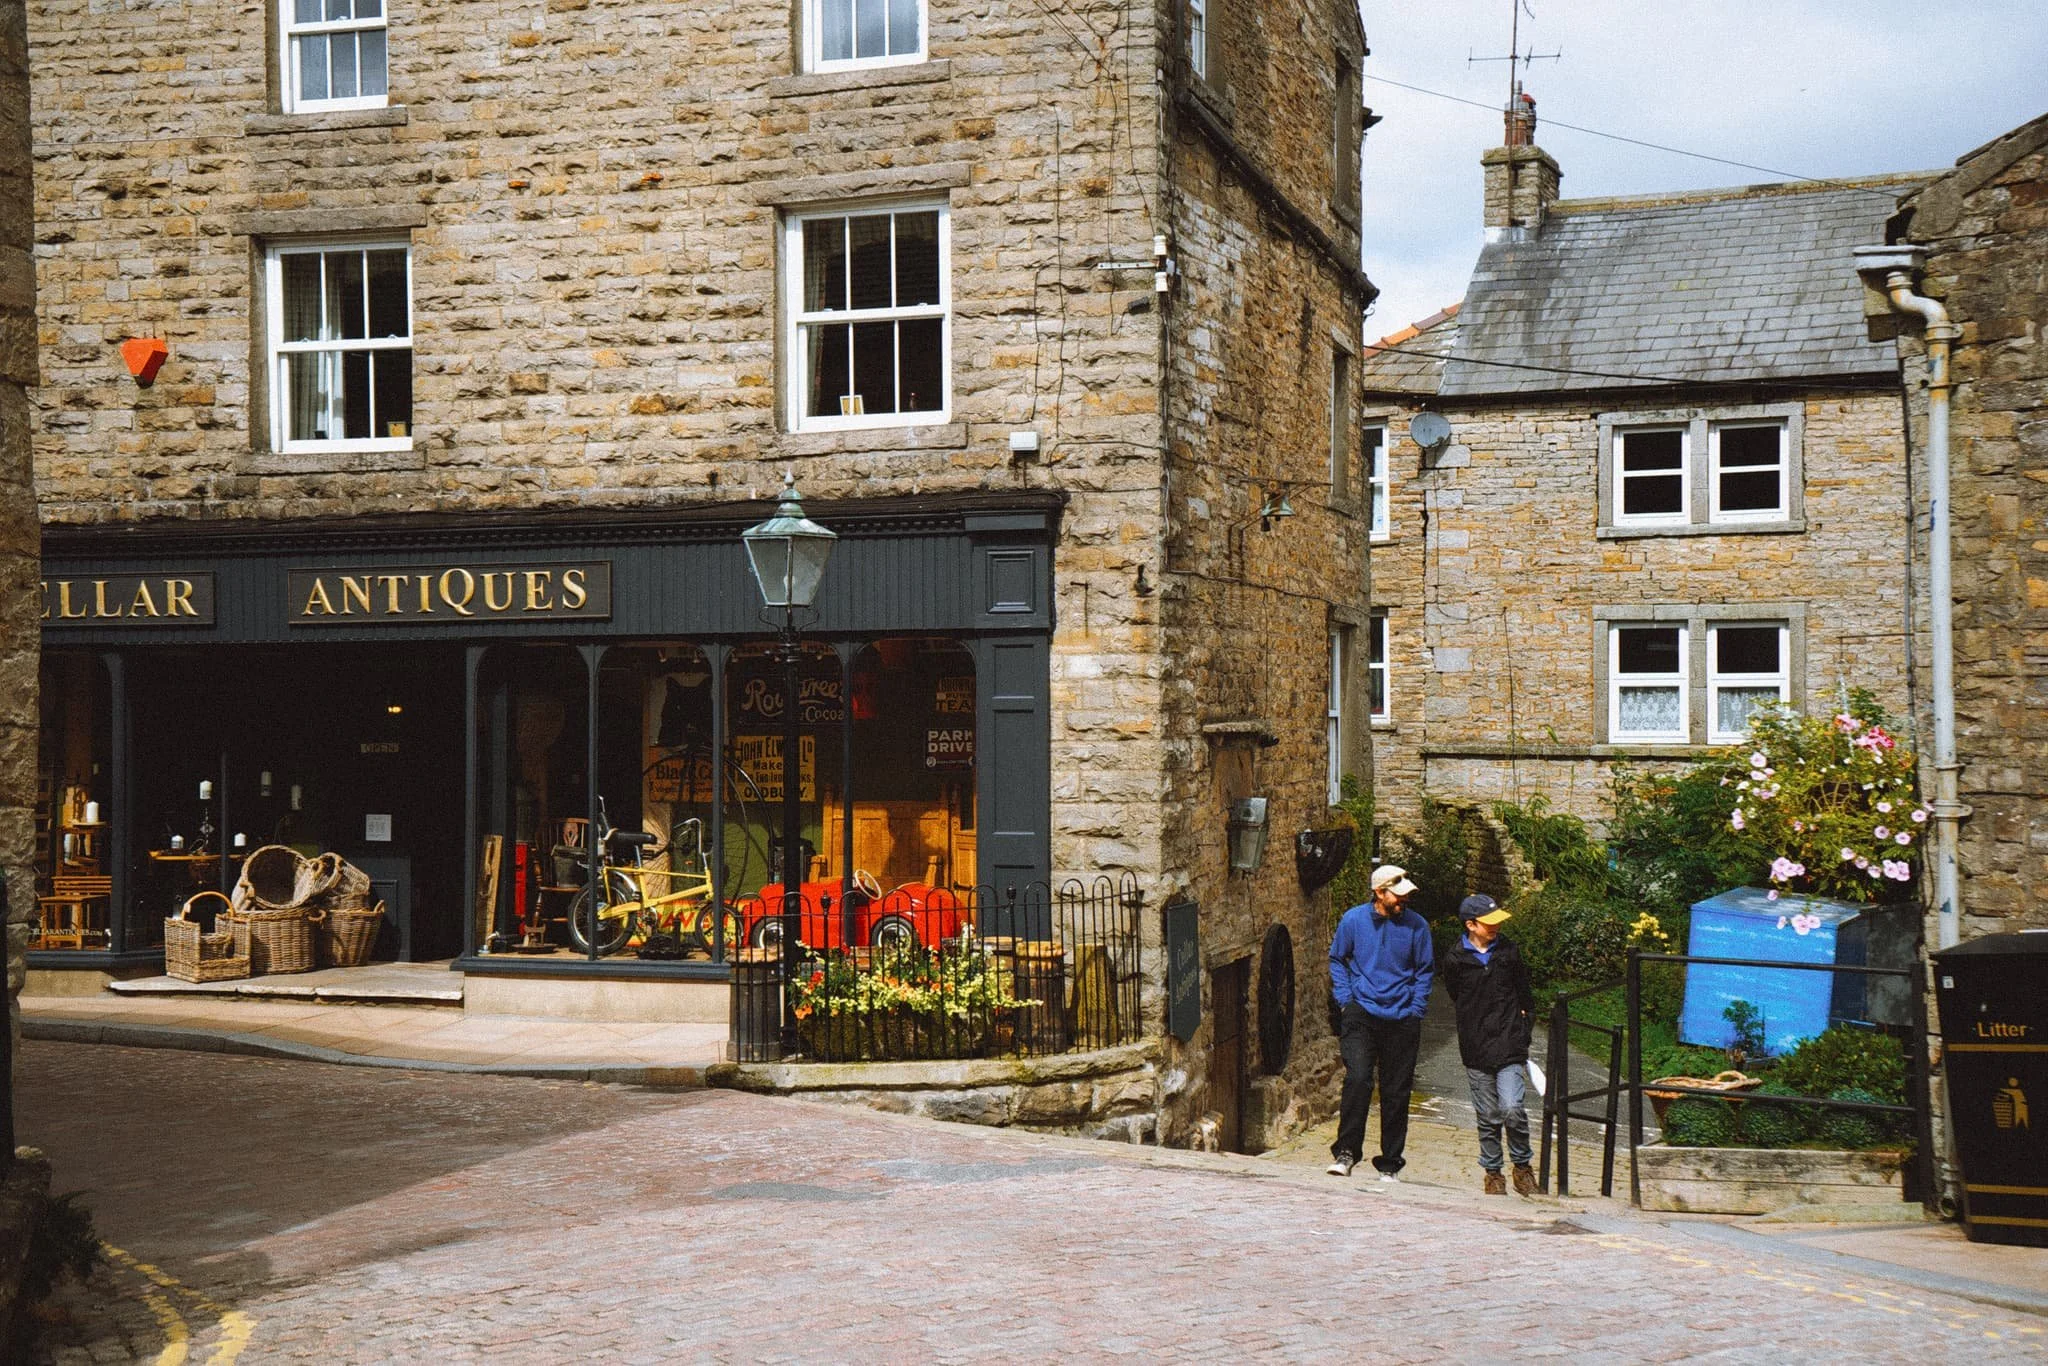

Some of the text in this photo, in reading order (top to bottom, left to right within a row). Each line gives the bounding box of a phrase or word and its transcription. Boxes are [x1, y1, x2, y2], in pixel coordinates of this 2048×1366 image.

[301, 567, 589, 617] ANTIQUES
[741, 679, 844, 717] Rotree
[927, 742, 973, 753] DRIVE
[743, 786, 808, 798] ODBUY.
[1976, 1021, 2028, 1038] Litter
